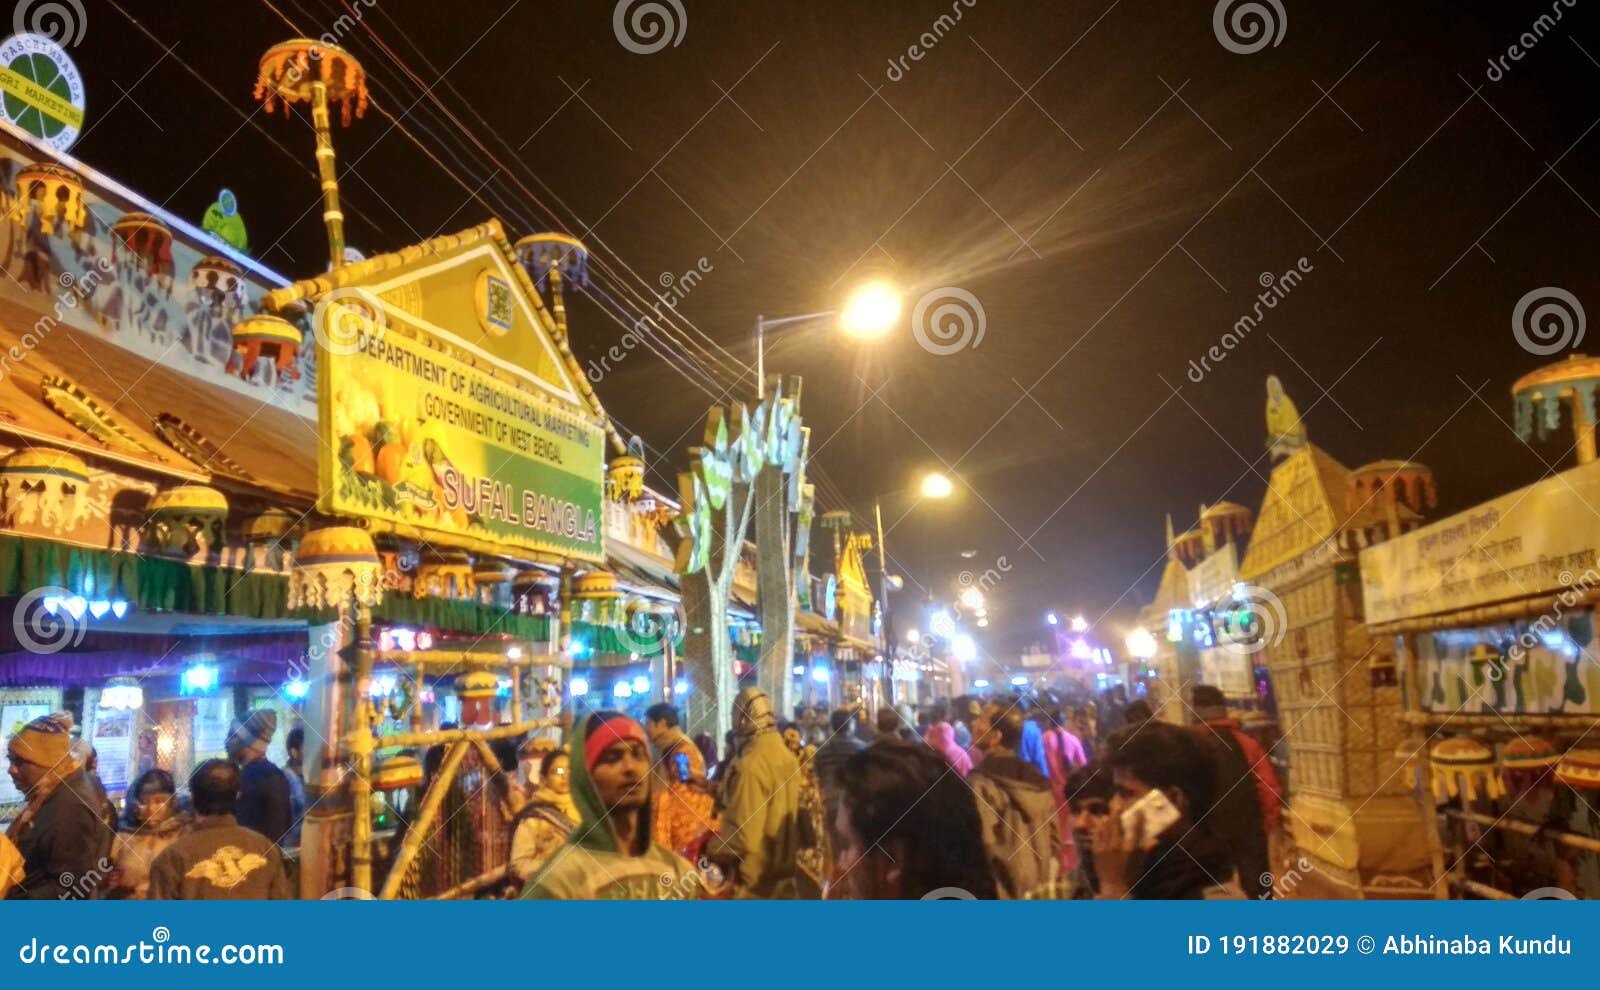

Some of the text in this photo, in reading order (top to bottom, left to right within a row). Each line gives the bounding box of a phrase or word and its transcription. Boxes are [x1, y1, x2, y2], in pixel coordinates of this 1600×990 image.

[357, 328, 589, 448] DEPARTMENT OF AGRICULTURAL MARKETING
[425, 391, 562, 465] GOVERNMENT OF WEST BENGAL
[442, 466, 520, 525] SUFAL
[522, 489, 597, 543] BANGLA
